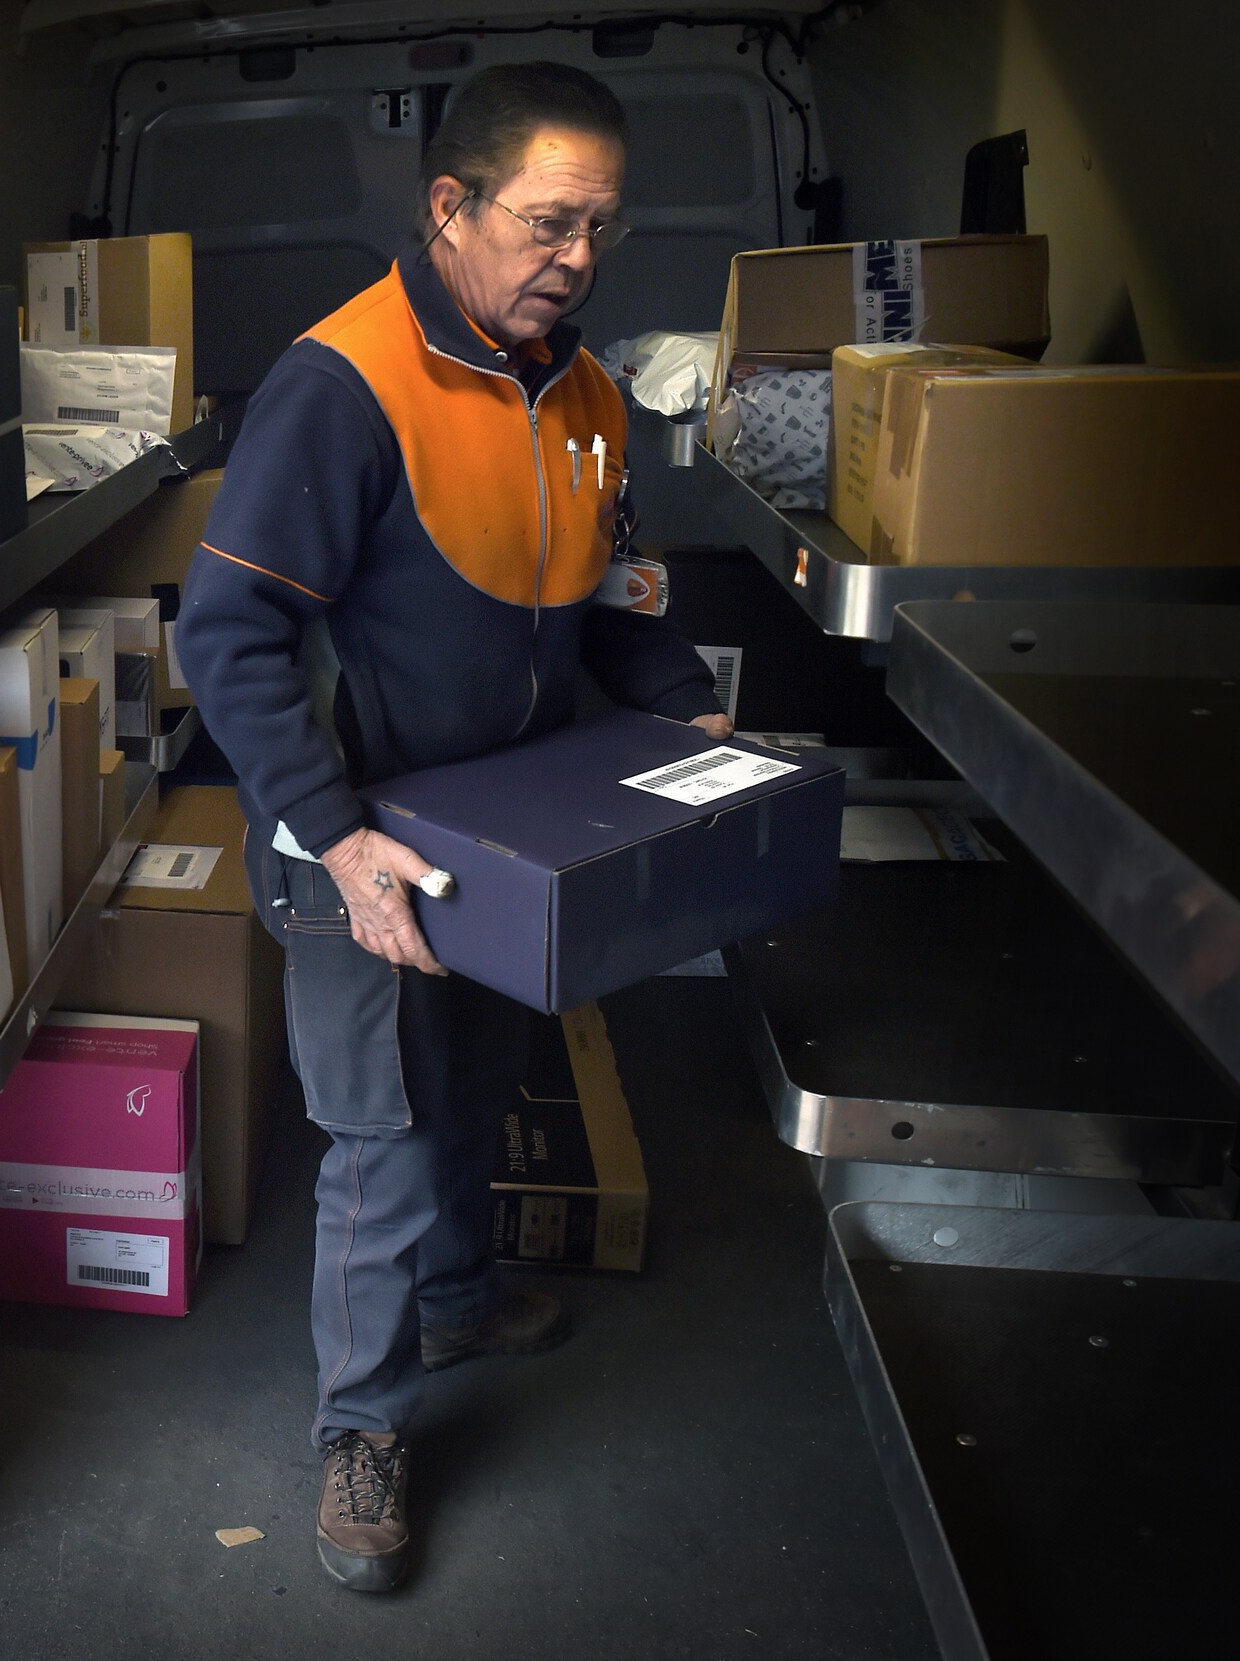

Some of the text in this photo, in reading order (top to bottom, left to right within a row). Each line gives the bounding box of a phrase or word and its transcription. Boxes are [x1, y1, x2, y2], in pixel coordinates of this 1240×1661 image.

[902, 247, 913, 291] Shoes
[866, 292, 877, 309] or
[503, 1112, 526, 1172] 21:9 UltraWide
[531, 1128, 548, 1161] Monitor
